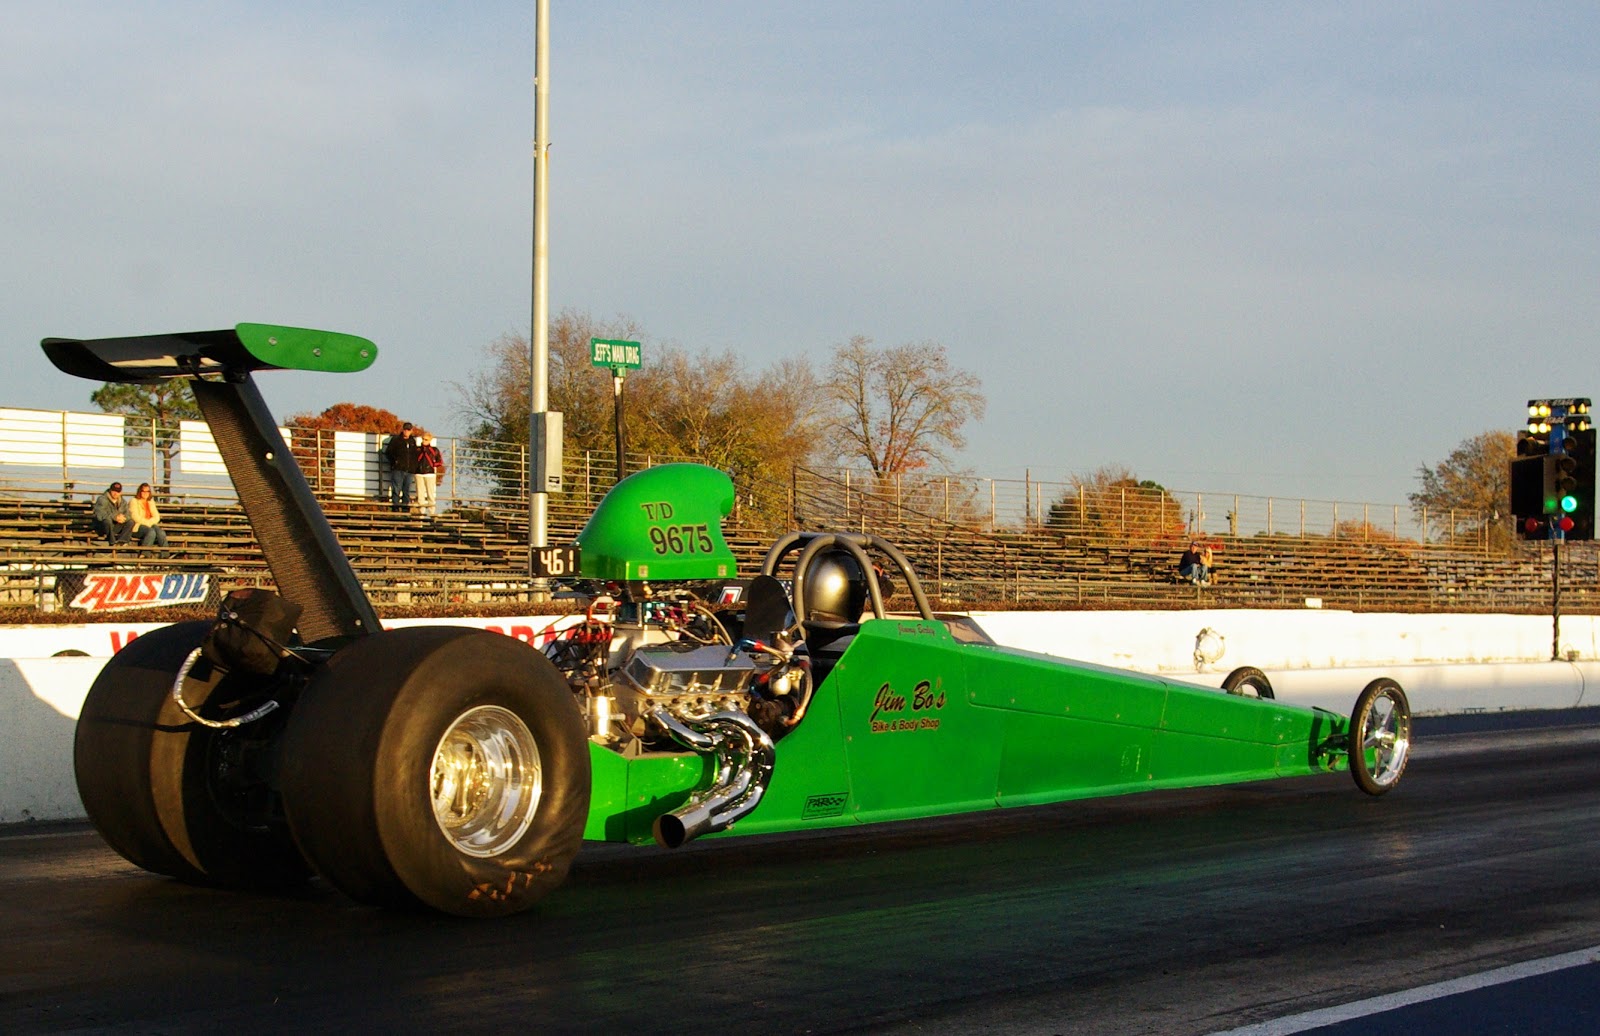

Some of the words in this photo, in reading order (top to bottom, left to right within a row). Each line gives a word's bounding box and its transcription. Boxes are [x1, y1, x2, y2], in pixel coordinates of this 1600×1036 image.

[625, 346, 640, 365] DRAG
[641, 502, 674, 520] T/D
[649, 524, 714, 556] 9675
[79, 573, 206, 611] AMSOIL
[869, 682, 905, 723] Jim
[912, 677, 946, 711] Bo's
[872, 720, 889, 733] Bike
[890, 720, 897, 732] &
[898, 718, 919, 732] Body
[920, 717, 940, 730] Shop
